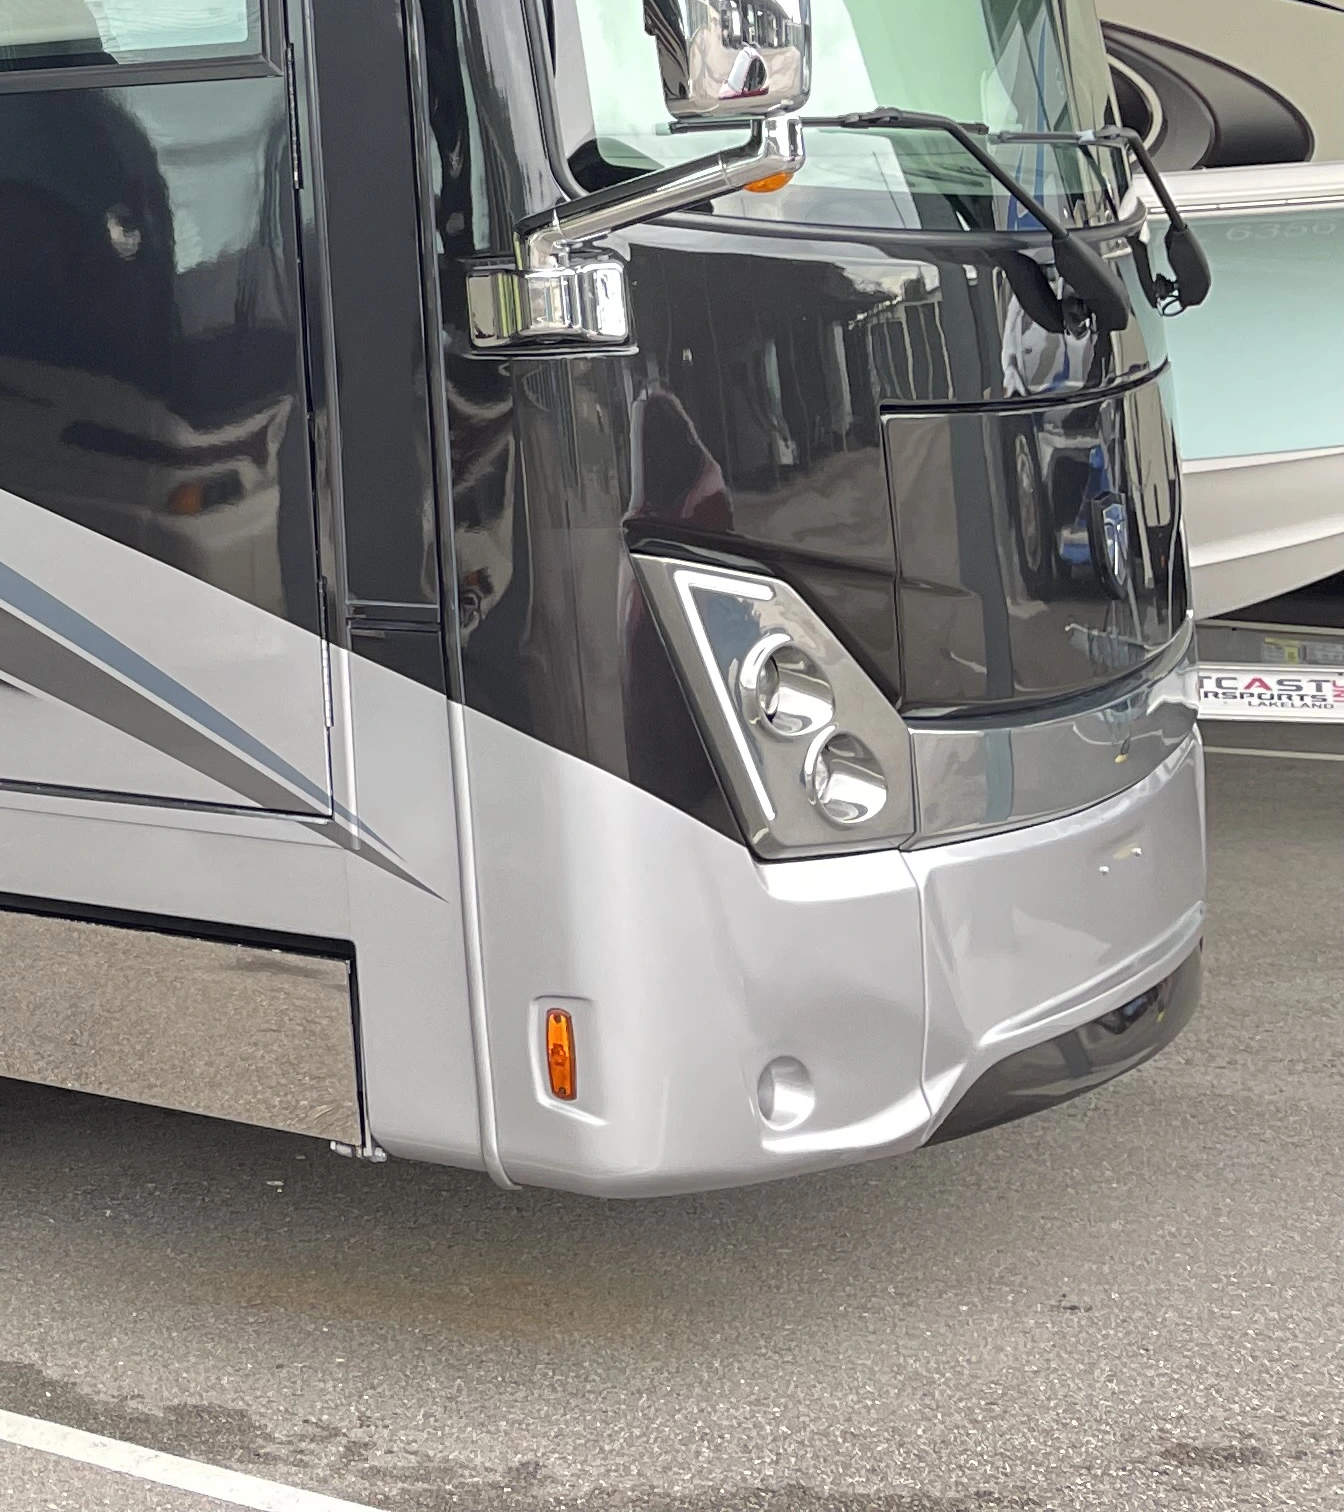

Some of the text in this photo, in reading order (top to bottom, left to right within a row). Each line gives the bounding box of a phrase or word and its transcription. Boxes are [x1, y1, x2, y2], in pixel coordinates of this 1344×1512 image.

[1198, 675, 1331, 693] TCAST
[1203, 690, 1328, 703] RSPORTS
[1248, 700, 1335, 710] LAKELAND
